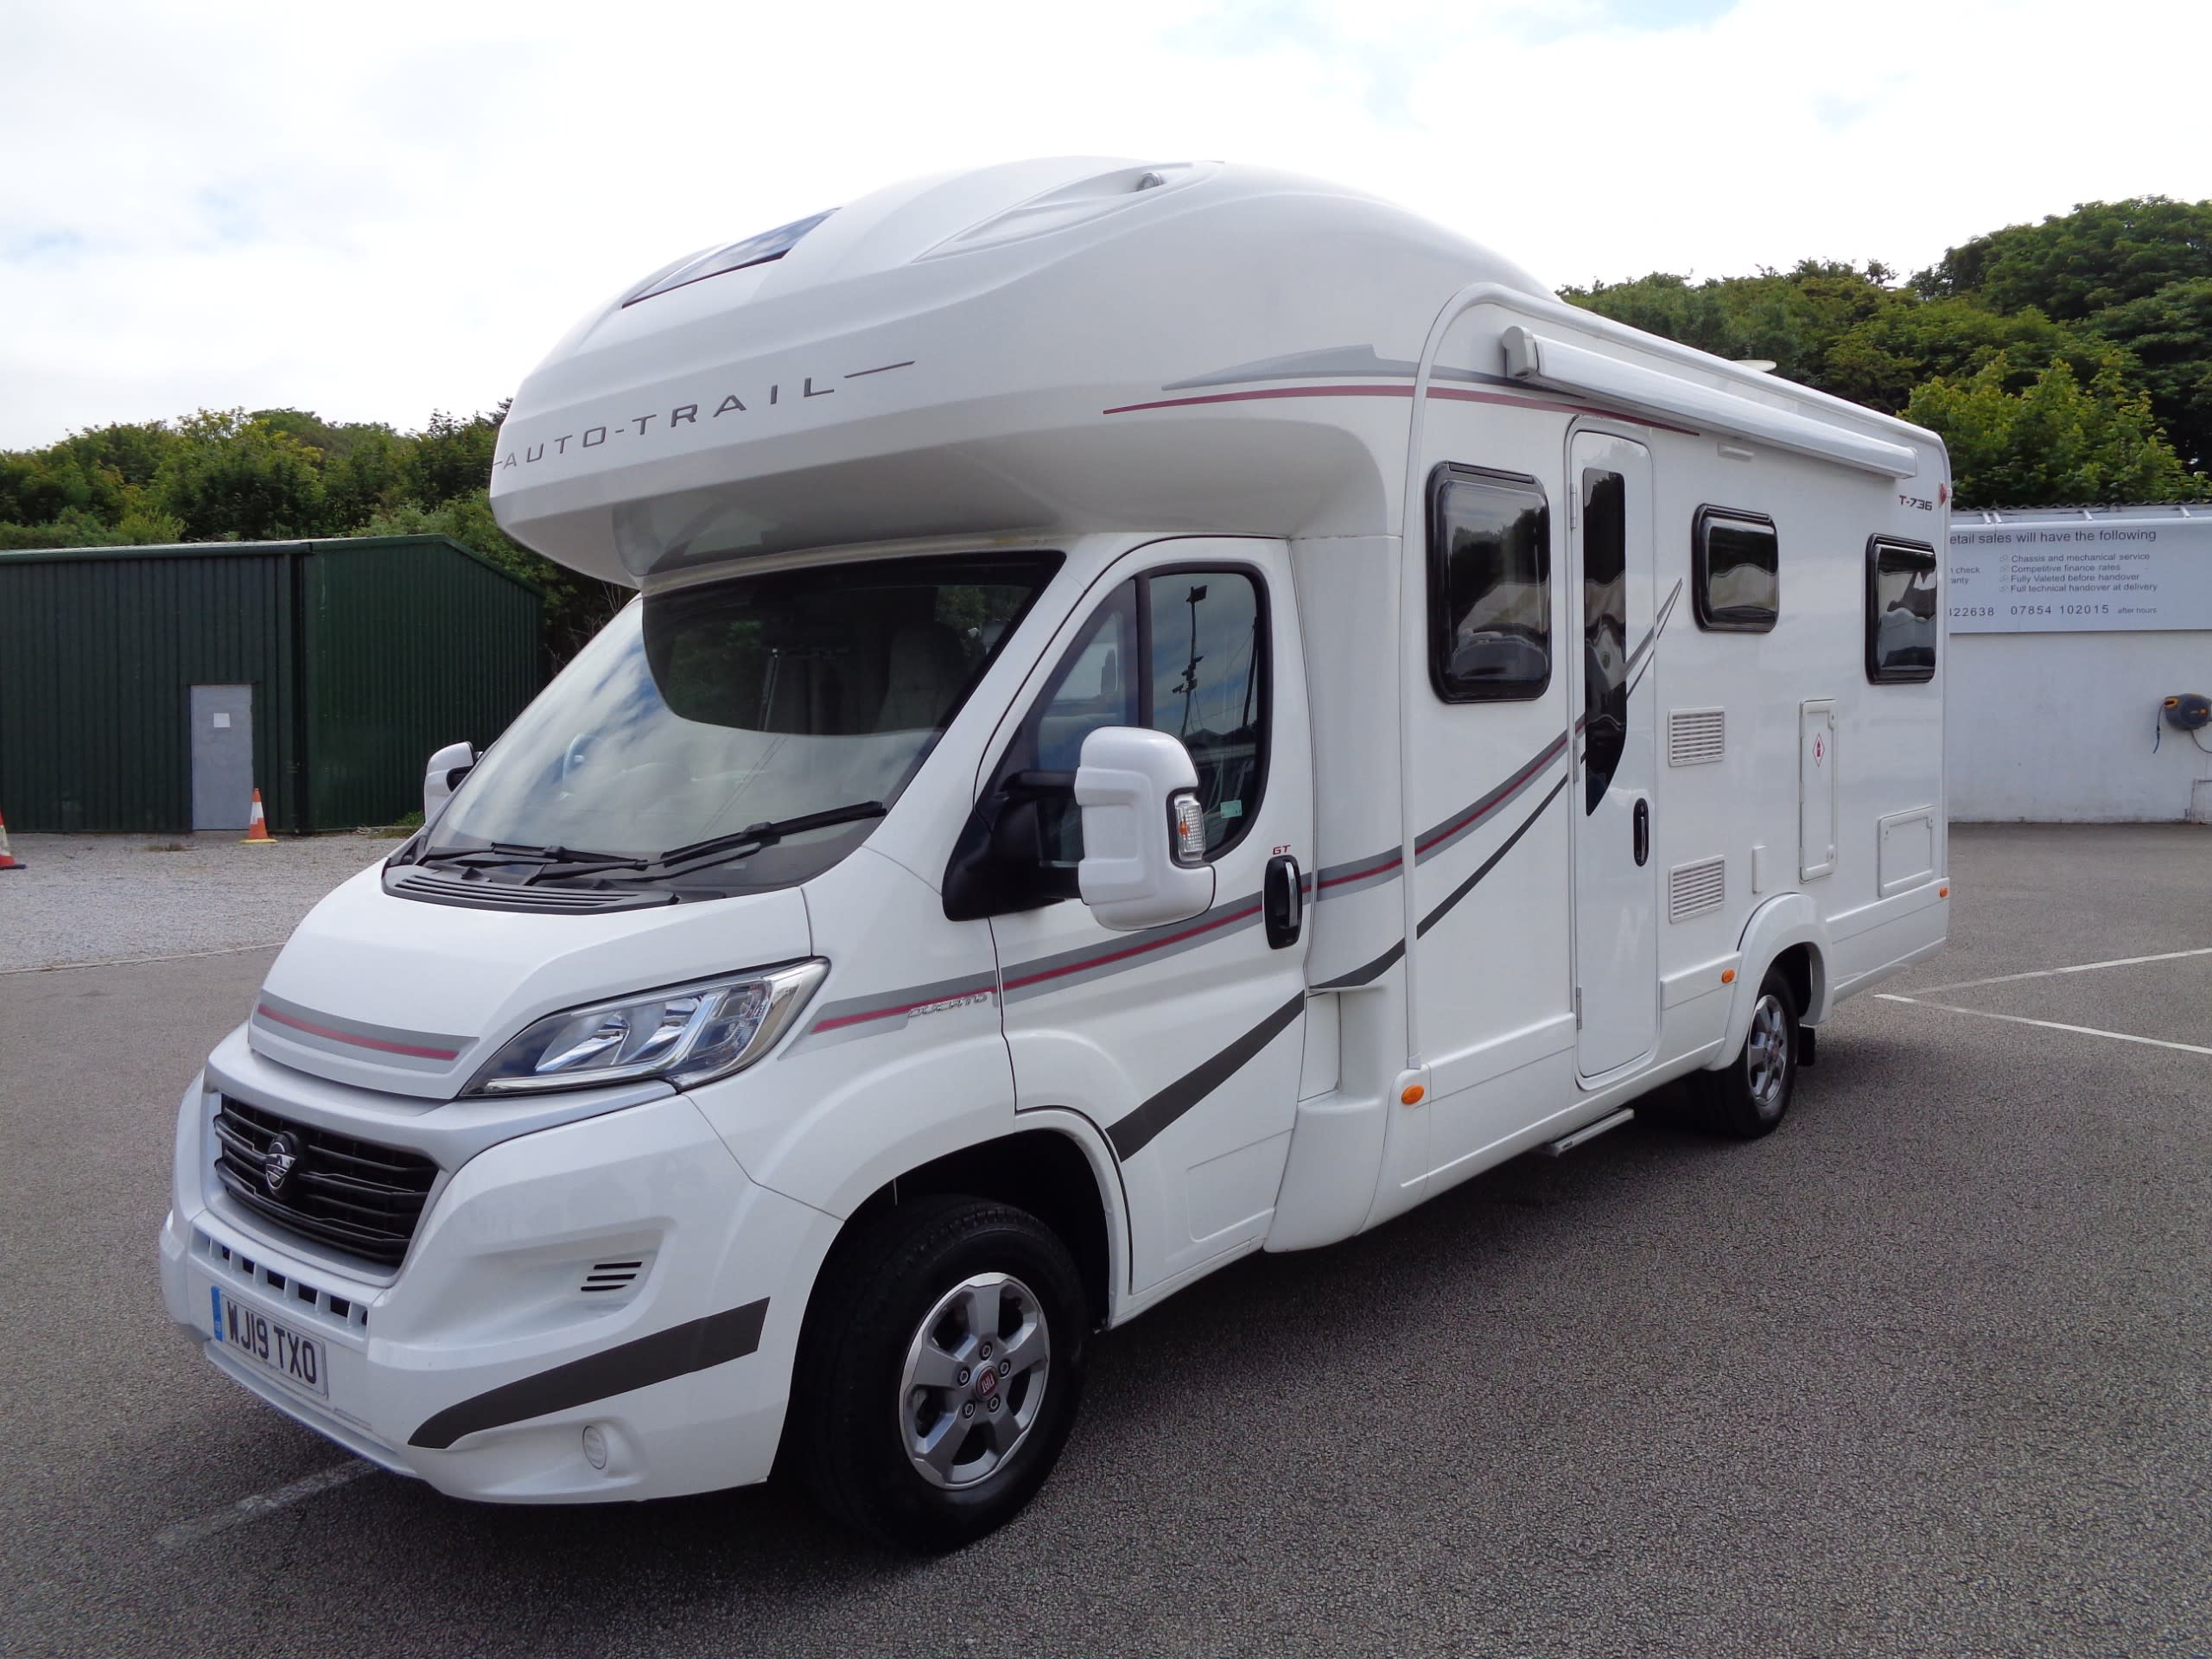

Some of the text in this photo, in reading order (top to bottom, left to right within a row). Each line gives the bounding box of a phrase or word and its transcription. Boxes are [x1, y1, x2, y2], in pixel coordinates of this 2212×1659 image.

[504, 377, 835, 470] AUTO-TRAIL
[1899, 494, 1933, 512] T-736
[1978, 533, 2012, 544] sales
[2017, 531, 2036, 543] will
[2040, 531, 2070, 543] have
[2075, 531, 2095, 542] the
[2100, 529, 2157, 543] following
[2066, 553, 2116, 562] mechanical
[2119, 552, 2150, 561] service
[2011, 565, 2062, 574] Competitive
[2064, 563, 2095, 572] finance
[2011, 575, 2031, 583] Fully
[2098, 573, 2140, 582] handover
[2011, 584, 2026, 593] Full
[2029, 584, 2066, 593] technical
[2069, 583, 2111, 592] handover
[2124, 583, 2158, 593] delivery
[2011, 605, 2052, 615] 07854
[2060, 604, 2109, 614] 102015
[1273, 844, 1291, 855] GT
[227, 1300, 317, 1384] WJ19 TXO
